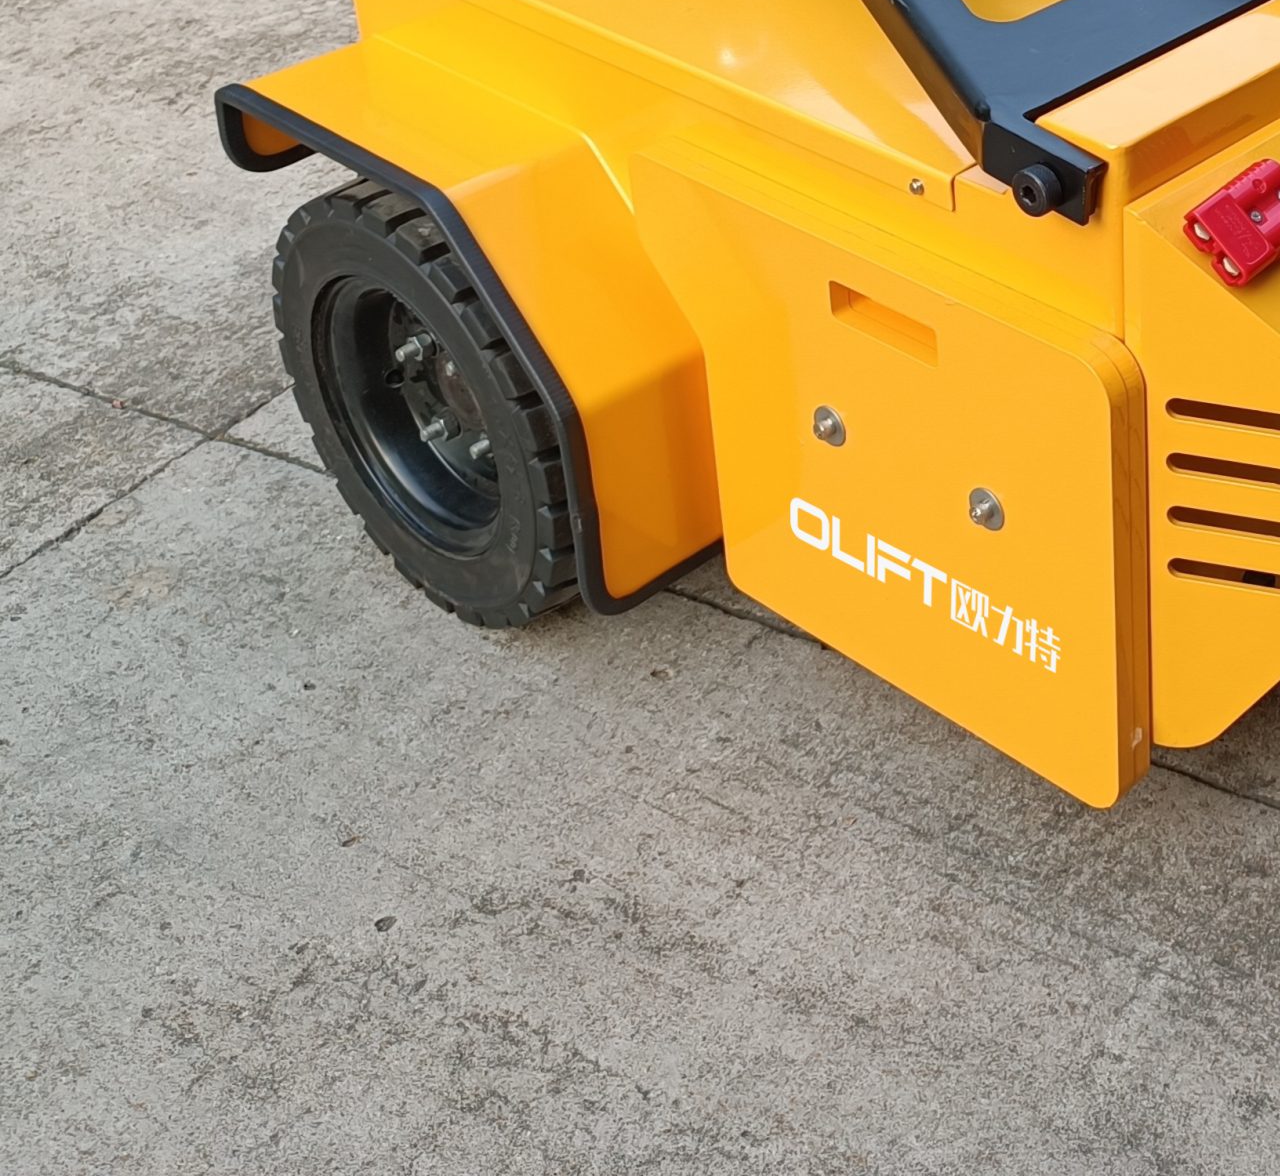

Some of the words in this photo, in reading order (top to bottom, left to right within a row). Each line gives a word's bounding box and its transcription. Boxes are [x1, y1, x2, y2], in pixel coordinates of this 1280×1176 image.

[790, 497, 947, 607] OLIFT
[950, 578, 1061, 673] 欧力特
